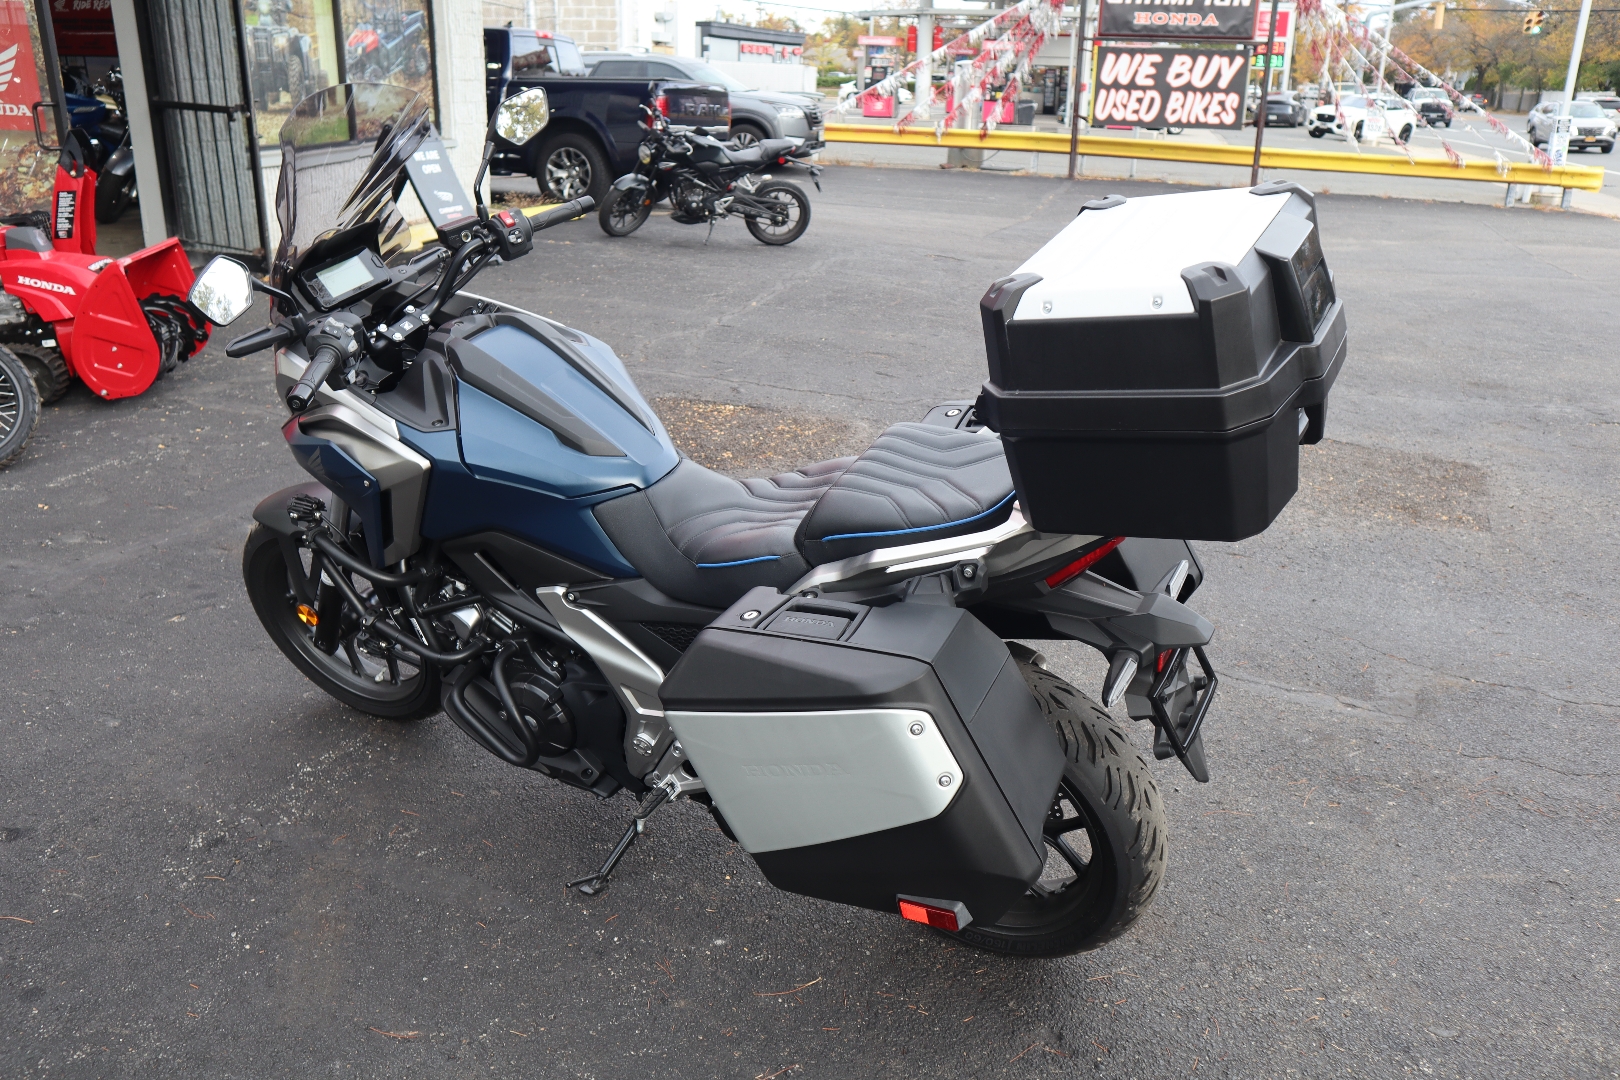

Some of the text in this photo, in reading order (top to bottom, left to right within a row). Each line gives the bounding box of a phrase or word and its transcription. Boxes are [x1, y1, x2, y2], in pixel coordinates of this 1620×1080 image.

[72, 0, 92, 11] RIDE
[1133, 12, 1219, 27] HONDA
[1100, 52, 1245, 90] WE BUY
[1094, 88, 1241, 126] USED BIKES
[413, 150, 441, 162] WE ARE
[421, 163, 442, 175] OPEN
[17, 275, 77, 296] HONDA
[785, 616, 835, 628] HONDA
[741, 763, 851, 777] HONDA
